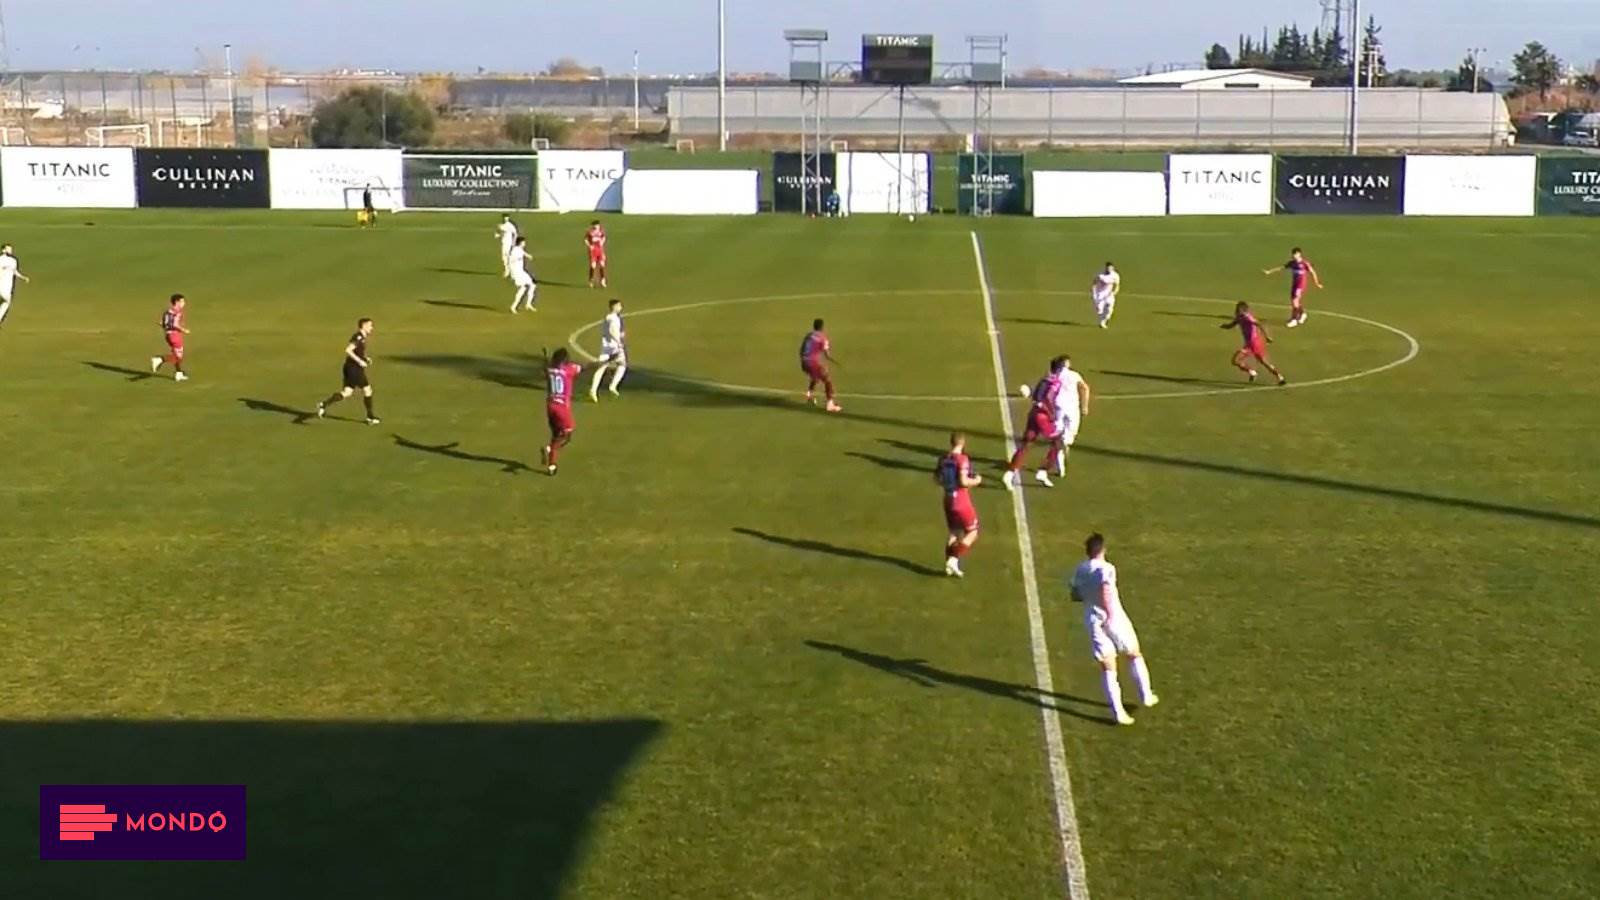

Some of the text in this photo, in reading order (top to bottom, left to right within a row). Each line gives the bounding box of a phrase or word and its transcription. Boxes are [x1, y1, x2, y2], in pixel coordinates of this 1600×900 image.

[876, 36, 919, 46] TITANIC
[27, 162, 111, 177] TITANIC
[153, 167, 255, 182] CULLINAN
[440, 164, 502, 177] TITANIC
[1181, 169, 1263, 184] TITANIC
[422, 178, 519, 188] LUXURY COLLECTION
[1288, 174, 1390, 189] CULLINAN
[549, 375, 564, 394] 10
